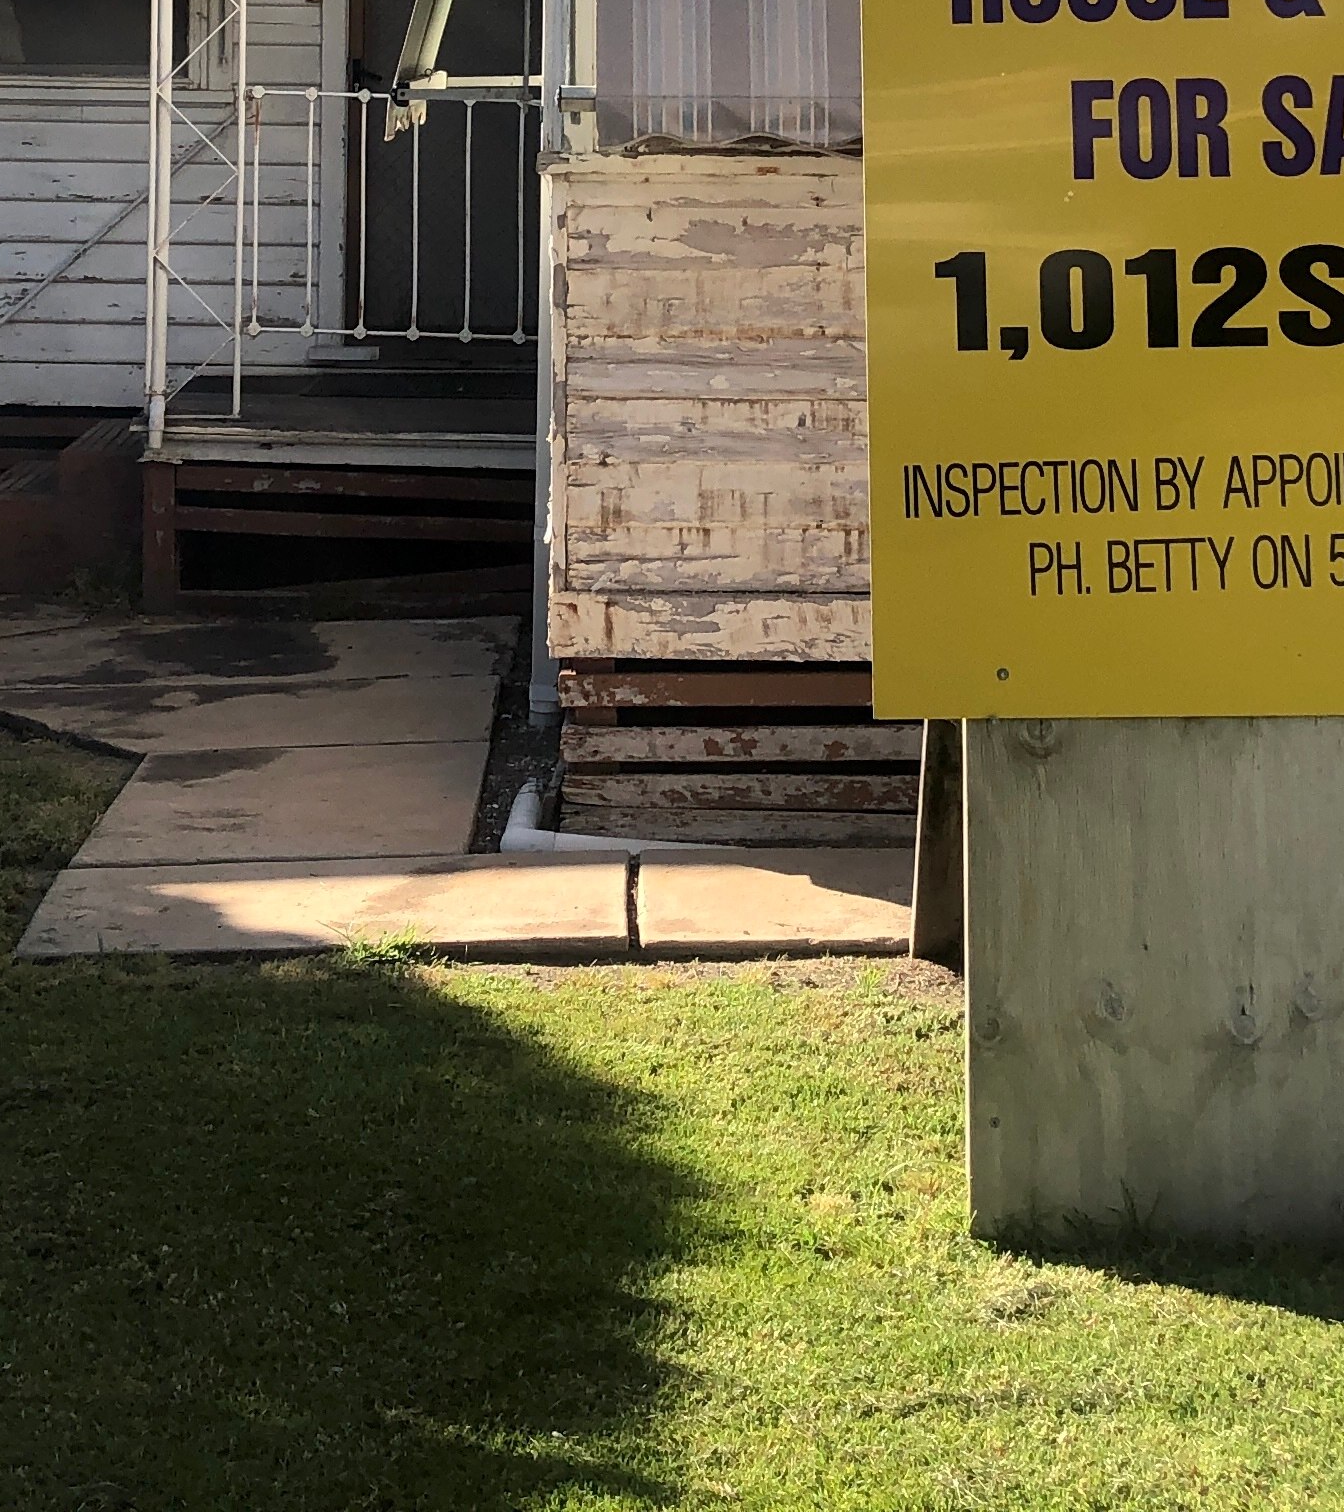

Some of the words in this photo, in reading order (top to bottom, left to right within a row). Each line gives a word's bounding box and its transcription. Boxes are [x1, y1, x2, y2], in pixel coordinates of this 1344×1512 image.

[1068, 75, 1232, 182] FOR
[901, 458, 1140, 520] INSPECTION
[1153, 456, 1205, 512] BY
[1028, 540, 1092, 598] PH.
[1106, 536, 1235, 595] BETTY
[1251, 533, 1313, 591] ON
